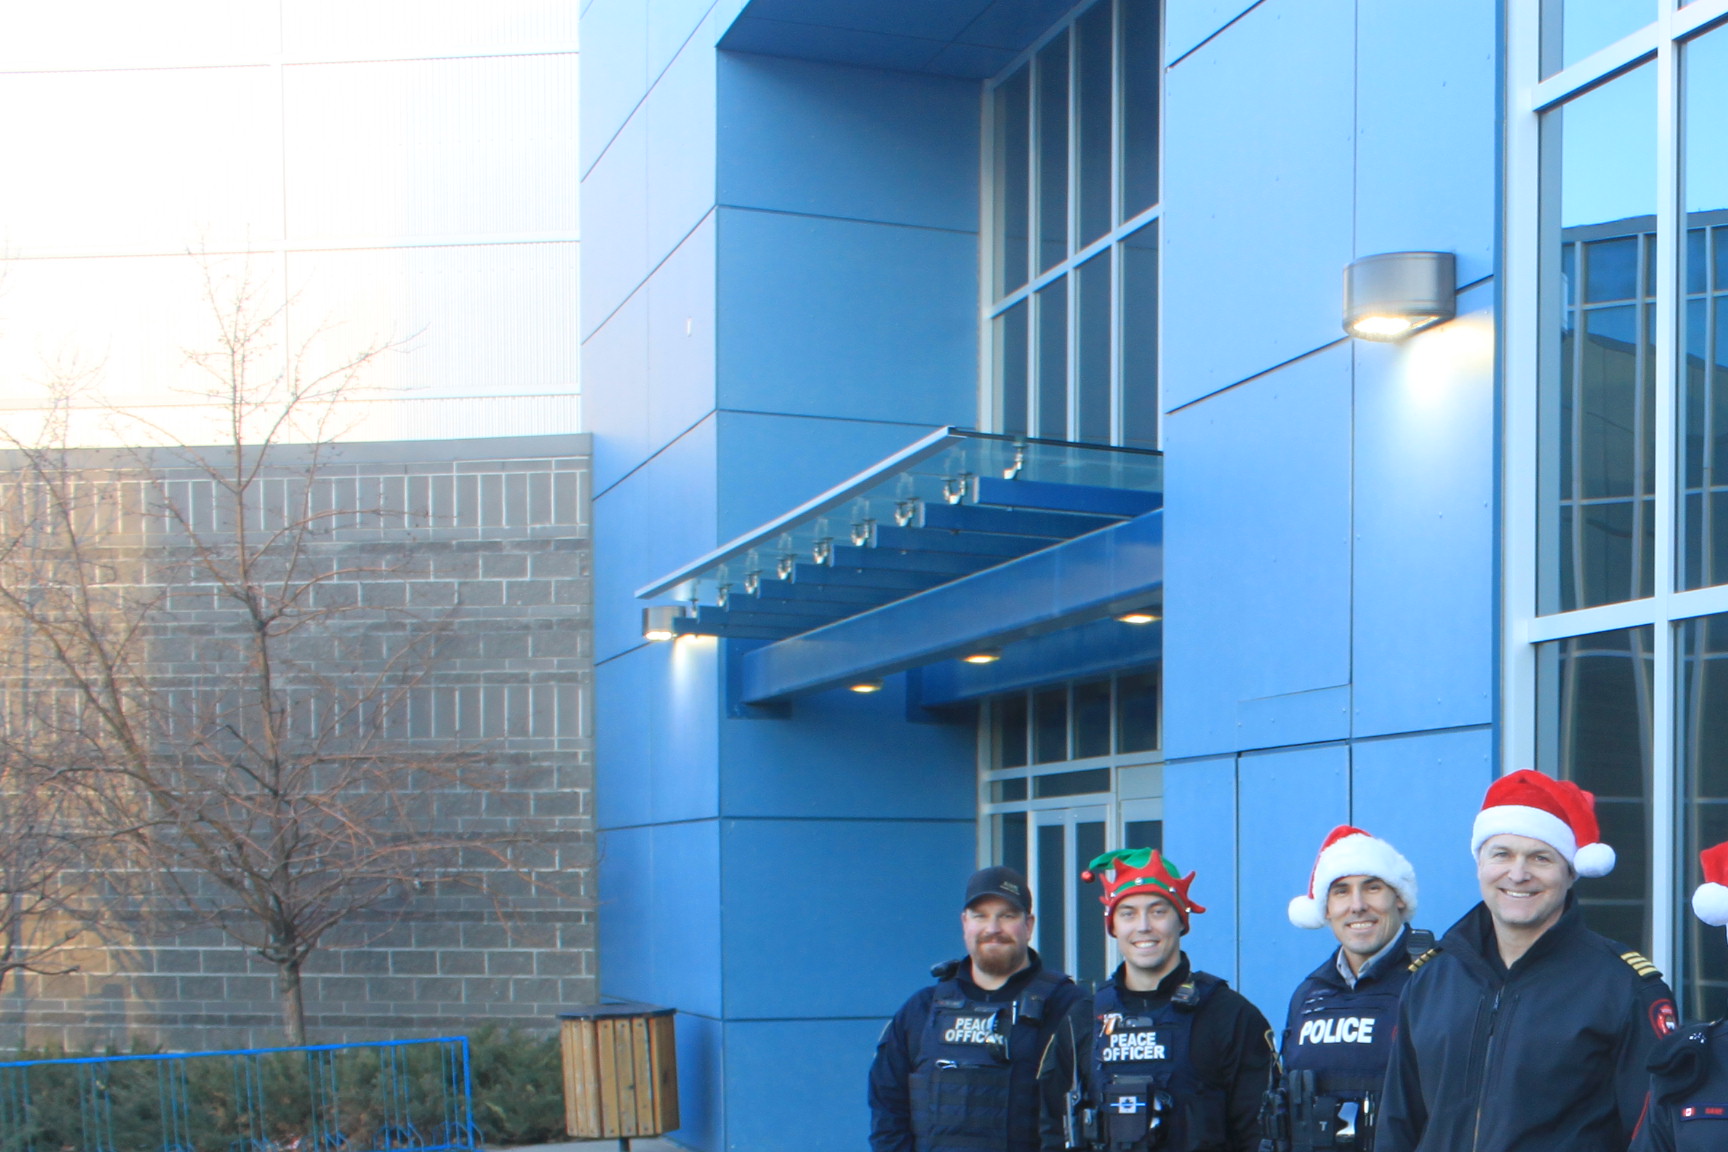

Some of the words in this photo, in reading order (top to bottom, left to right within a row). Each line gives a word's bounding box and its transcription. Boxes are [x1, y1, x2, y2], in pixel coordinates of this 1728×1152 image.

[1299, 1017, 1375, 1045] POLICE
[1110, 1032, 1156, 1047] PEACE
[1103, 1045, 1165, 1061] OFFICER
